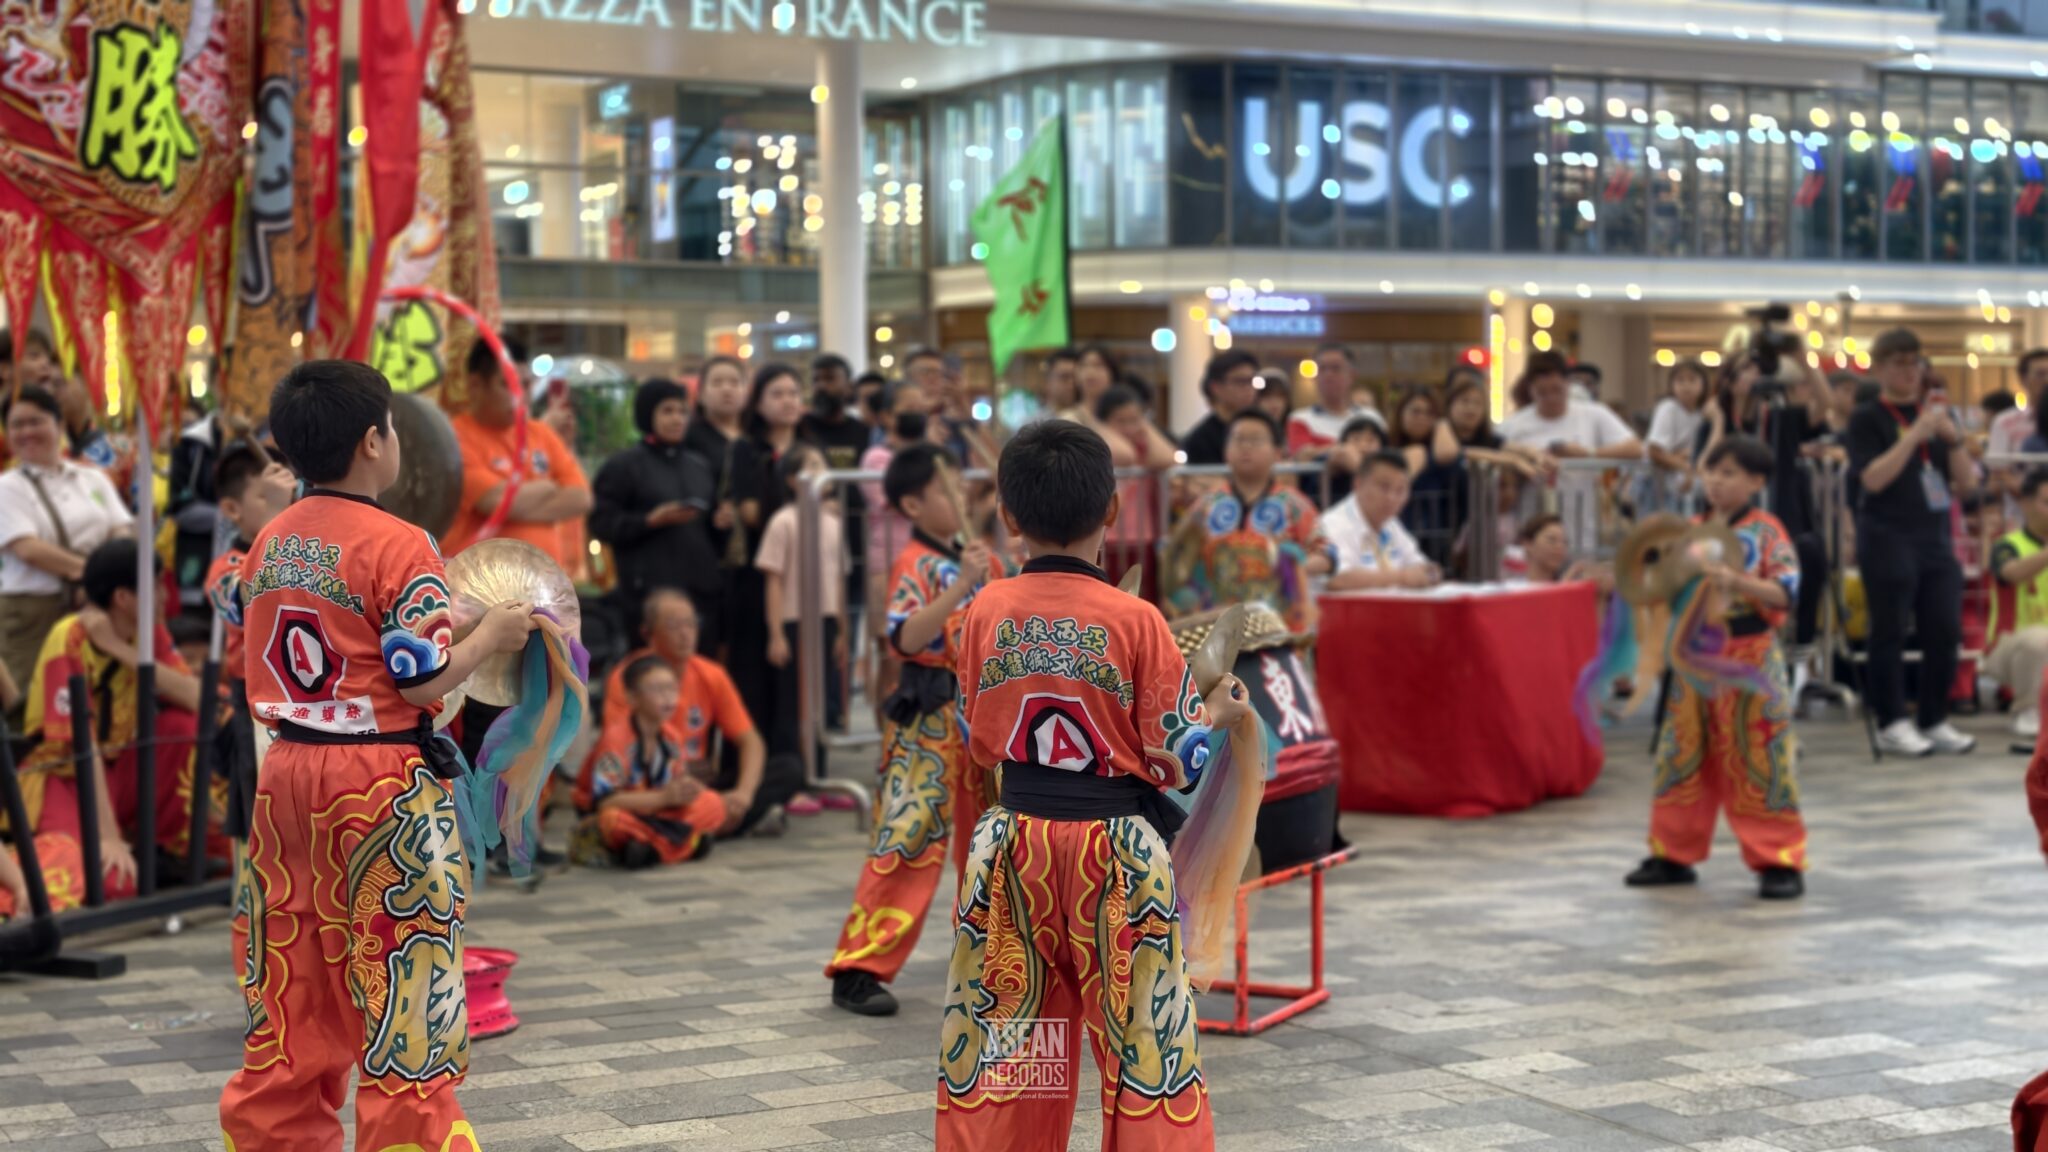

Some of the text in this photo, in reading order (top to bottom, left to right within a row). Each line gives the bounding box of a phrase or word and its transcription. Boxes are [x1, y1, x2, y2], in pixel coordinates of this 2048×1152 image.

[1242, 96, 1473, 208] USC
[263, 534, 342, 573] 馬來西亞
[995, 615, 1109, 658] 馬來西亞
